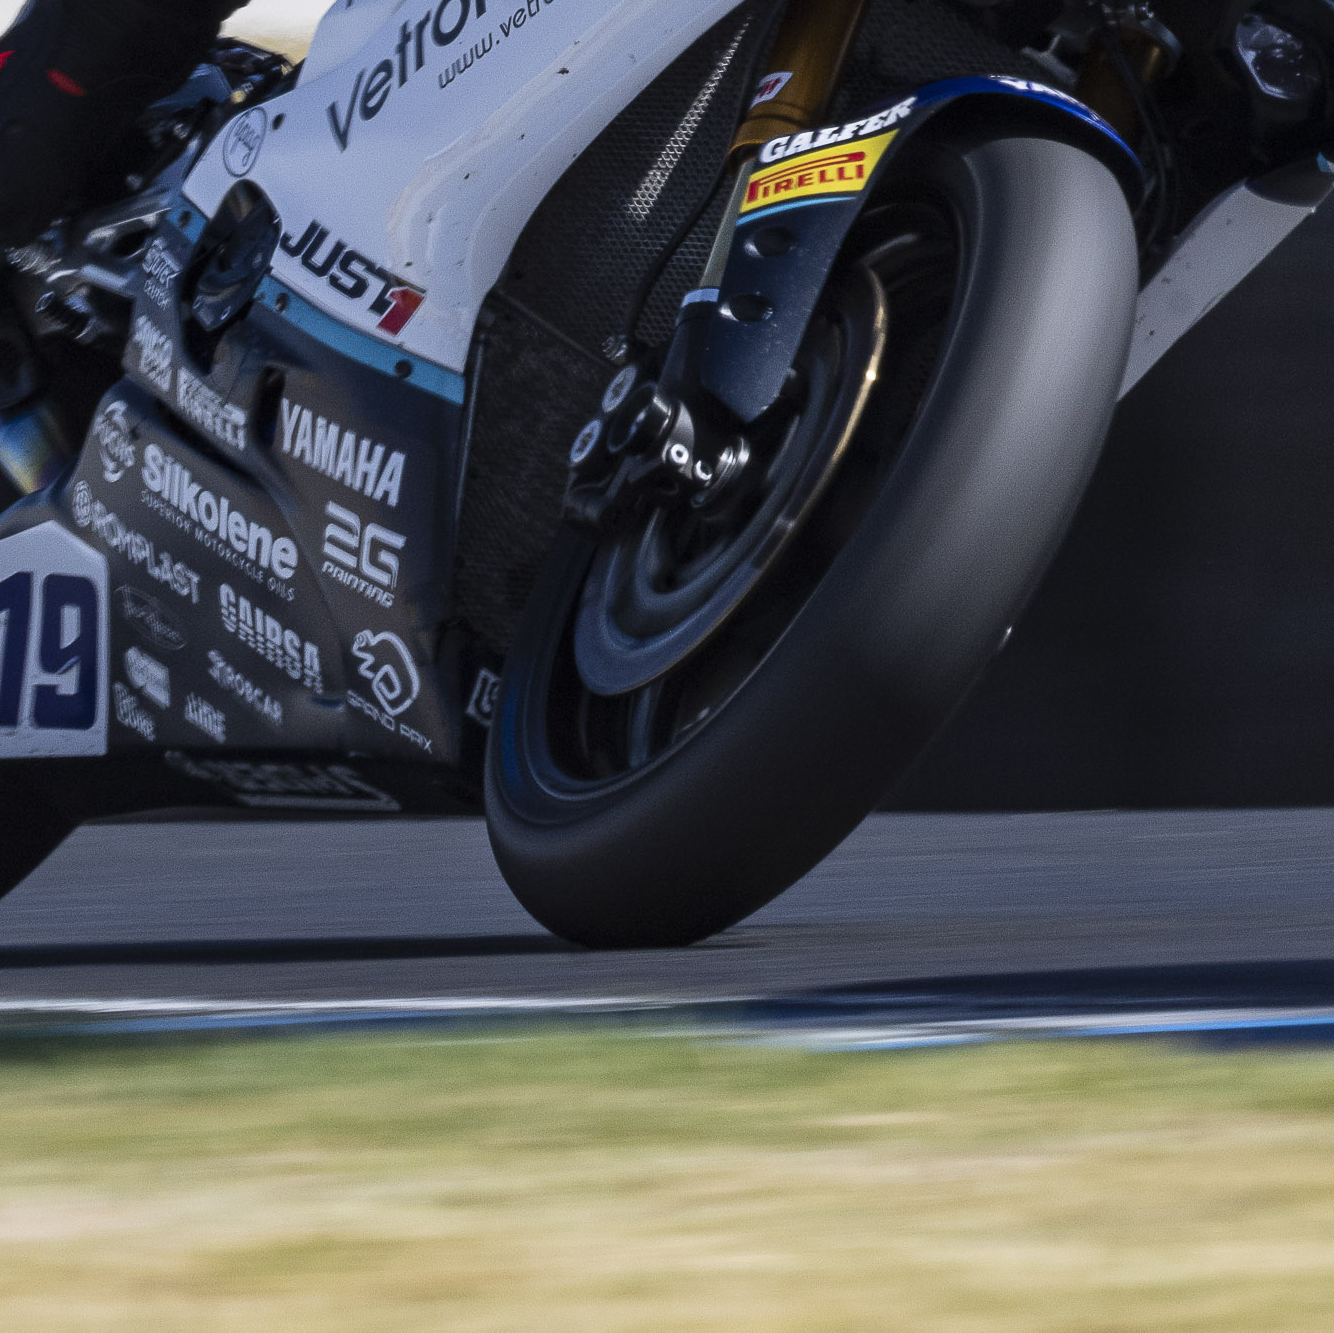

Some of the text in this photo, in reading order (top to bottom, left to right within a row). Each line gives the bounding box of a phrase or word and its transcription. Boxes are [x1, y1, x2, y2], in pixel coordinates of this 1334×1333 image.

[760, 96, 918, 163] GALFER
[746, 151, 866, 203] PIRELLI
[281, 397, 407, 507] YAMAHA
[141, 443, 299, 580] Silkolene
